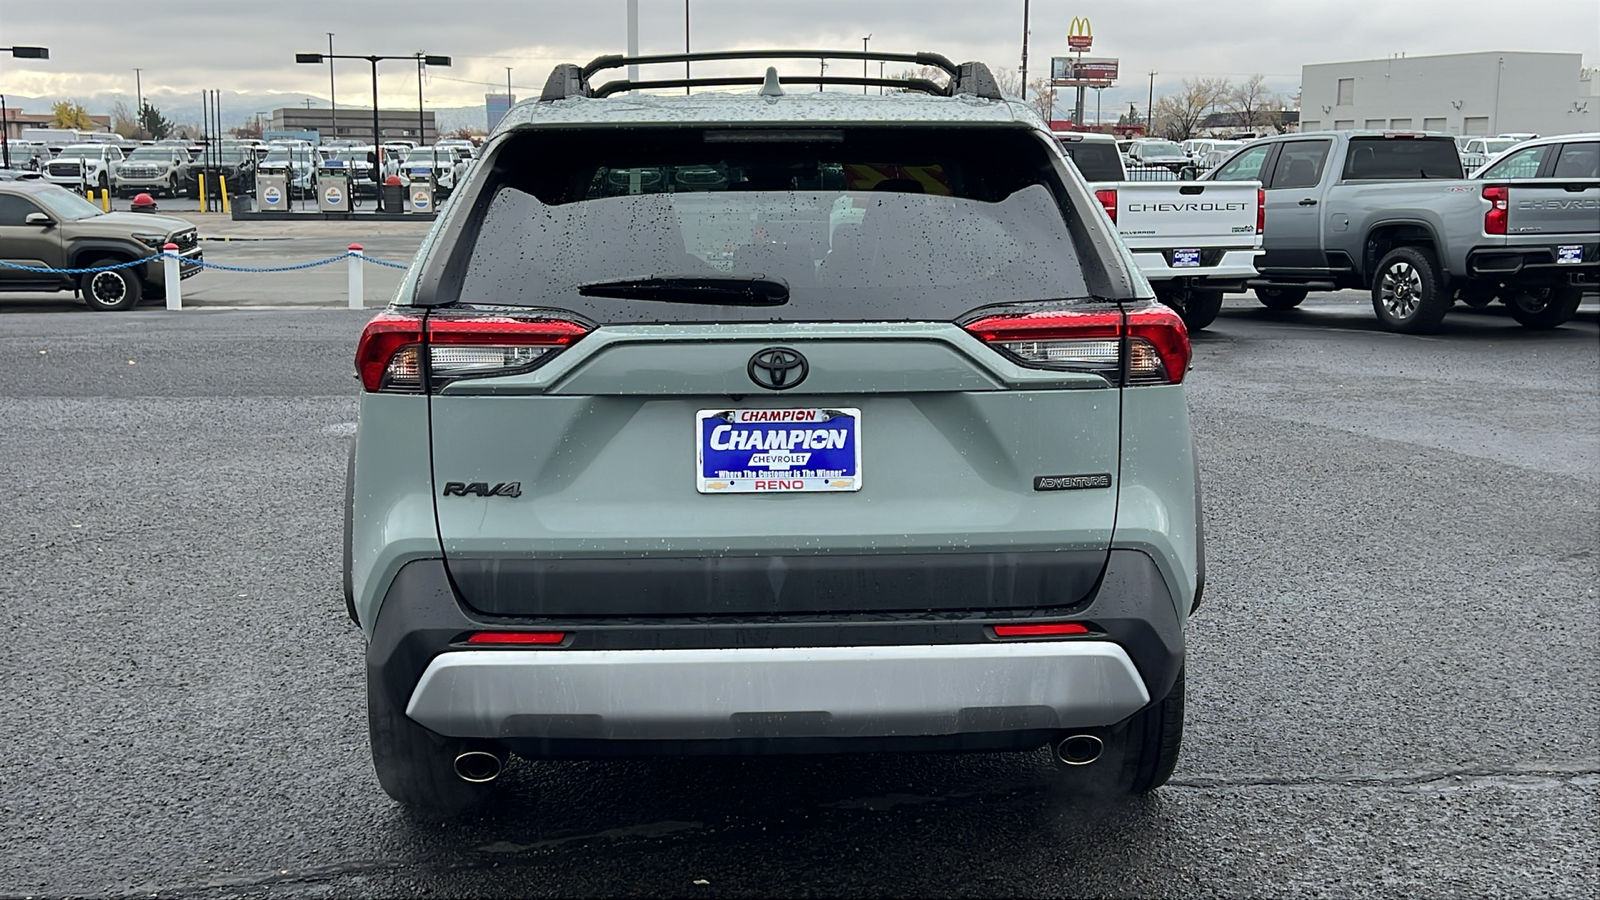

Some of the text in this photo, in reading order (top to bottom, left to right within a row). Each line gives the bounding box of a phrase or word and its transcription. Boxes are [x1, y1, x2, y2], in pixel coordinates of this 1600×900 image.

[1128, 202, 1249, 212] CHEVROLET
[1518, 200, 1600, 210] CHEVRO
[741, 411, 816, 421] CHAMPION
[710, 424, 848, 451] CHAMPION
[752, 455, 806, 463] CHEVROLET
[743, 470, 757, 478] The
[759, 470, 792, 478] Customer
[802, 469, 816, 477] The
[755, 480, 804, 490] RENO
[1039, 476, 1108, 488] ADVENTURE
[443, 481, 522, 499] RAV4
